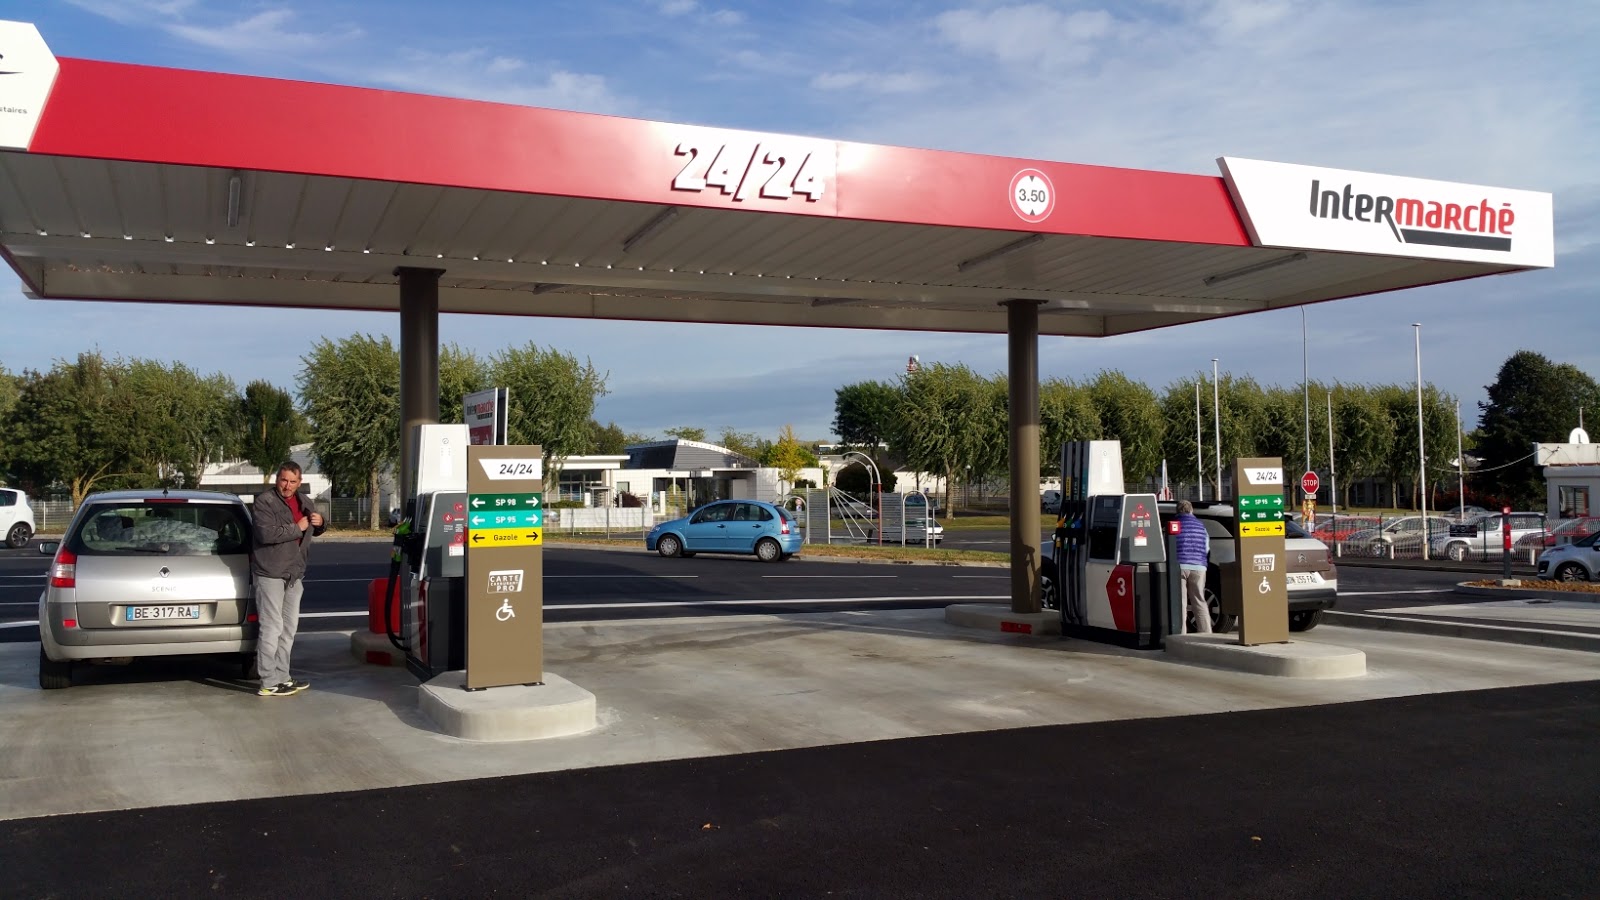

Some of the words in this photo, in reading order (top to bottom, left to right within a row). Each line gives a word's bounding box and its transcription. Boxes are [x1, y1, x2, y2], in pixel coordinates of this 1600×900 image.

[671, 141, 825, 202] 24/24
[1019, 188, 1046, 202] 3.50
[499, 463, 533, 476] 24/24
[1256, 471, 1277, 481] 24/24
[495, 498, 506, 506] SP
[495, 516, 506, 524] SP
[507, 515, 517, 523] 95
[490, 574, 520, 583] CARTE
[1117, 577, 1126, 596] 3
[134, 607, 192, 618] BE-317-RA
